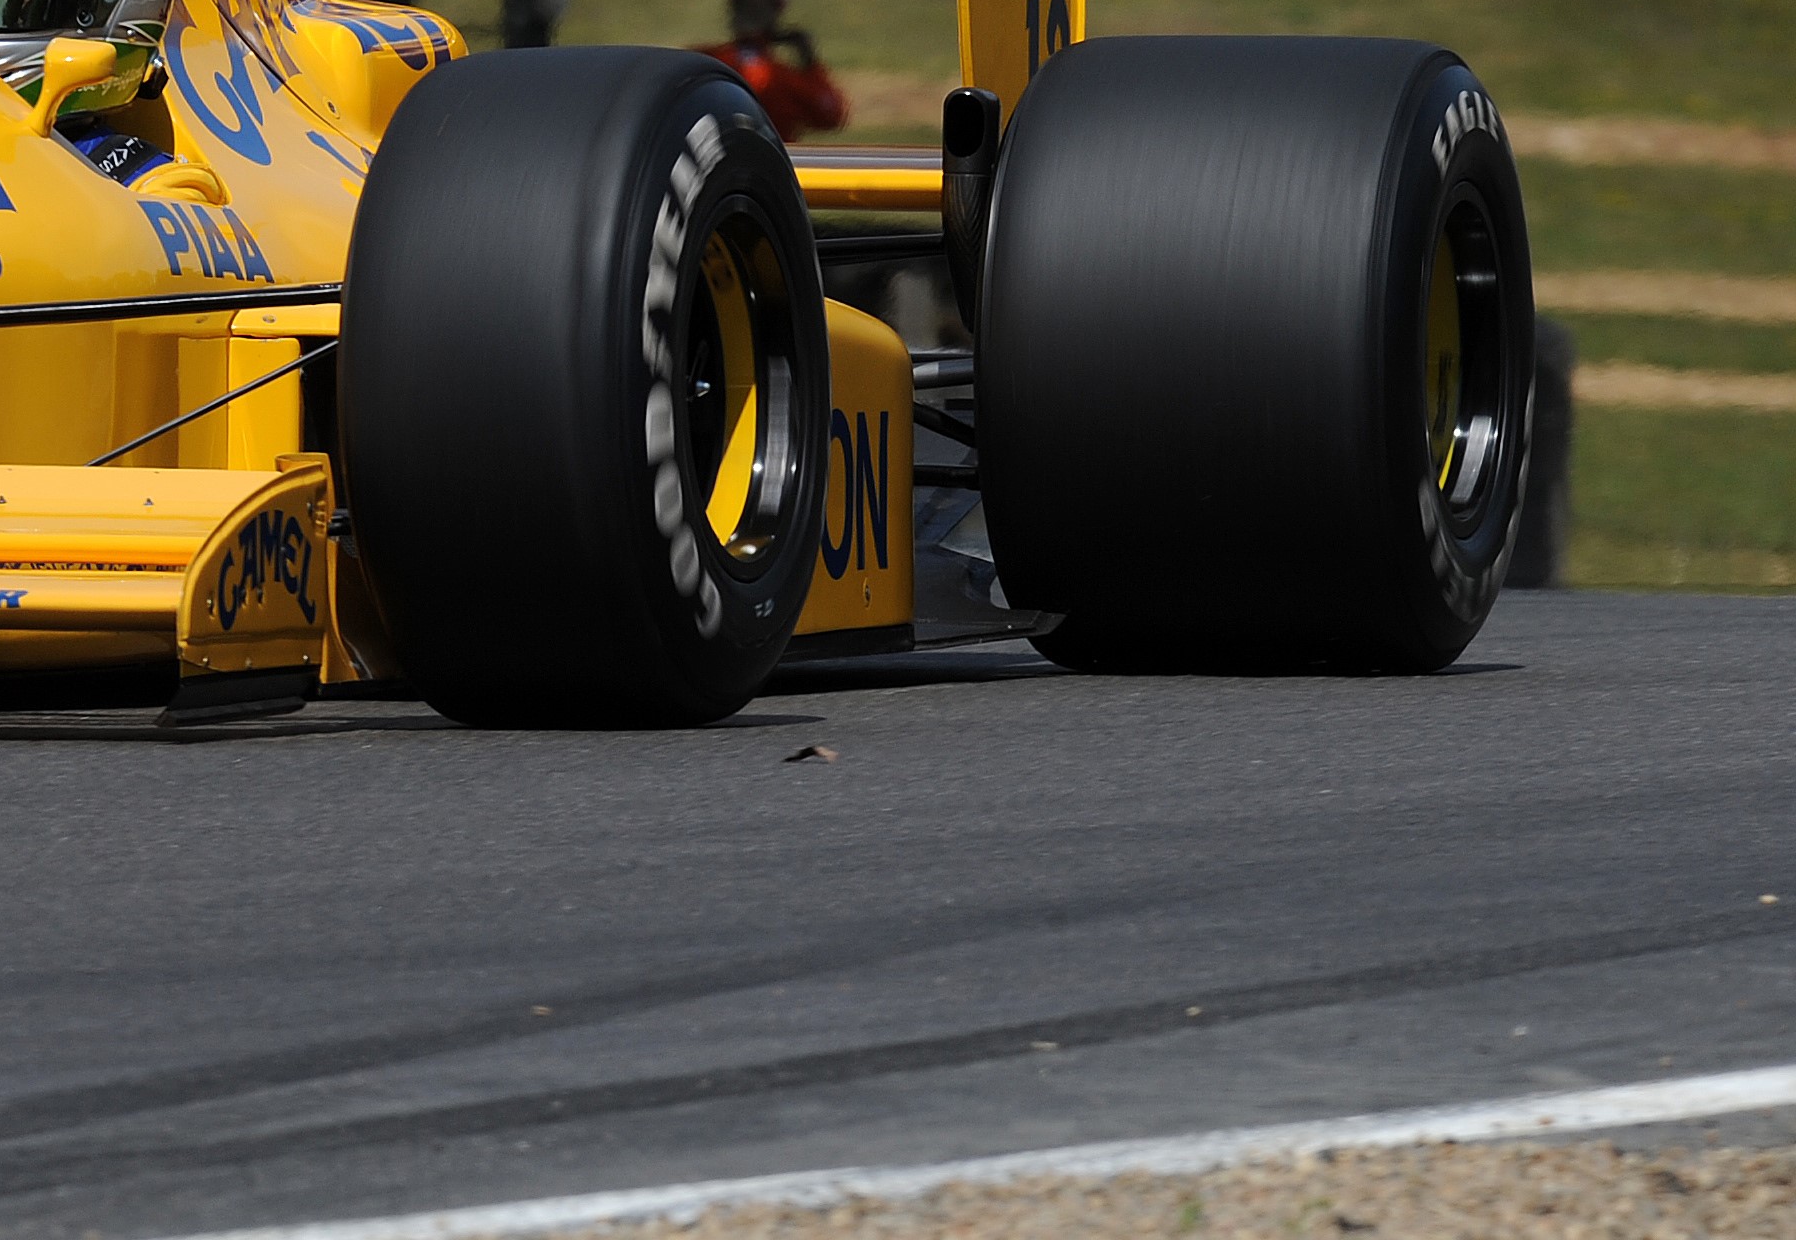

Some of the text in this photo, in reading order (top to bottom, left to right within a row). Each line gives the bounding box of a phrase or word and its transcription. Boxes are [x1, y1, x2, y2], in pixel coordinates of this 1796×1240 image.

[1431, 90, 1500, 180] EAGLE
[137, 200, 275, 283] PIAA
[218, 509, 317, 632] CAMEL
